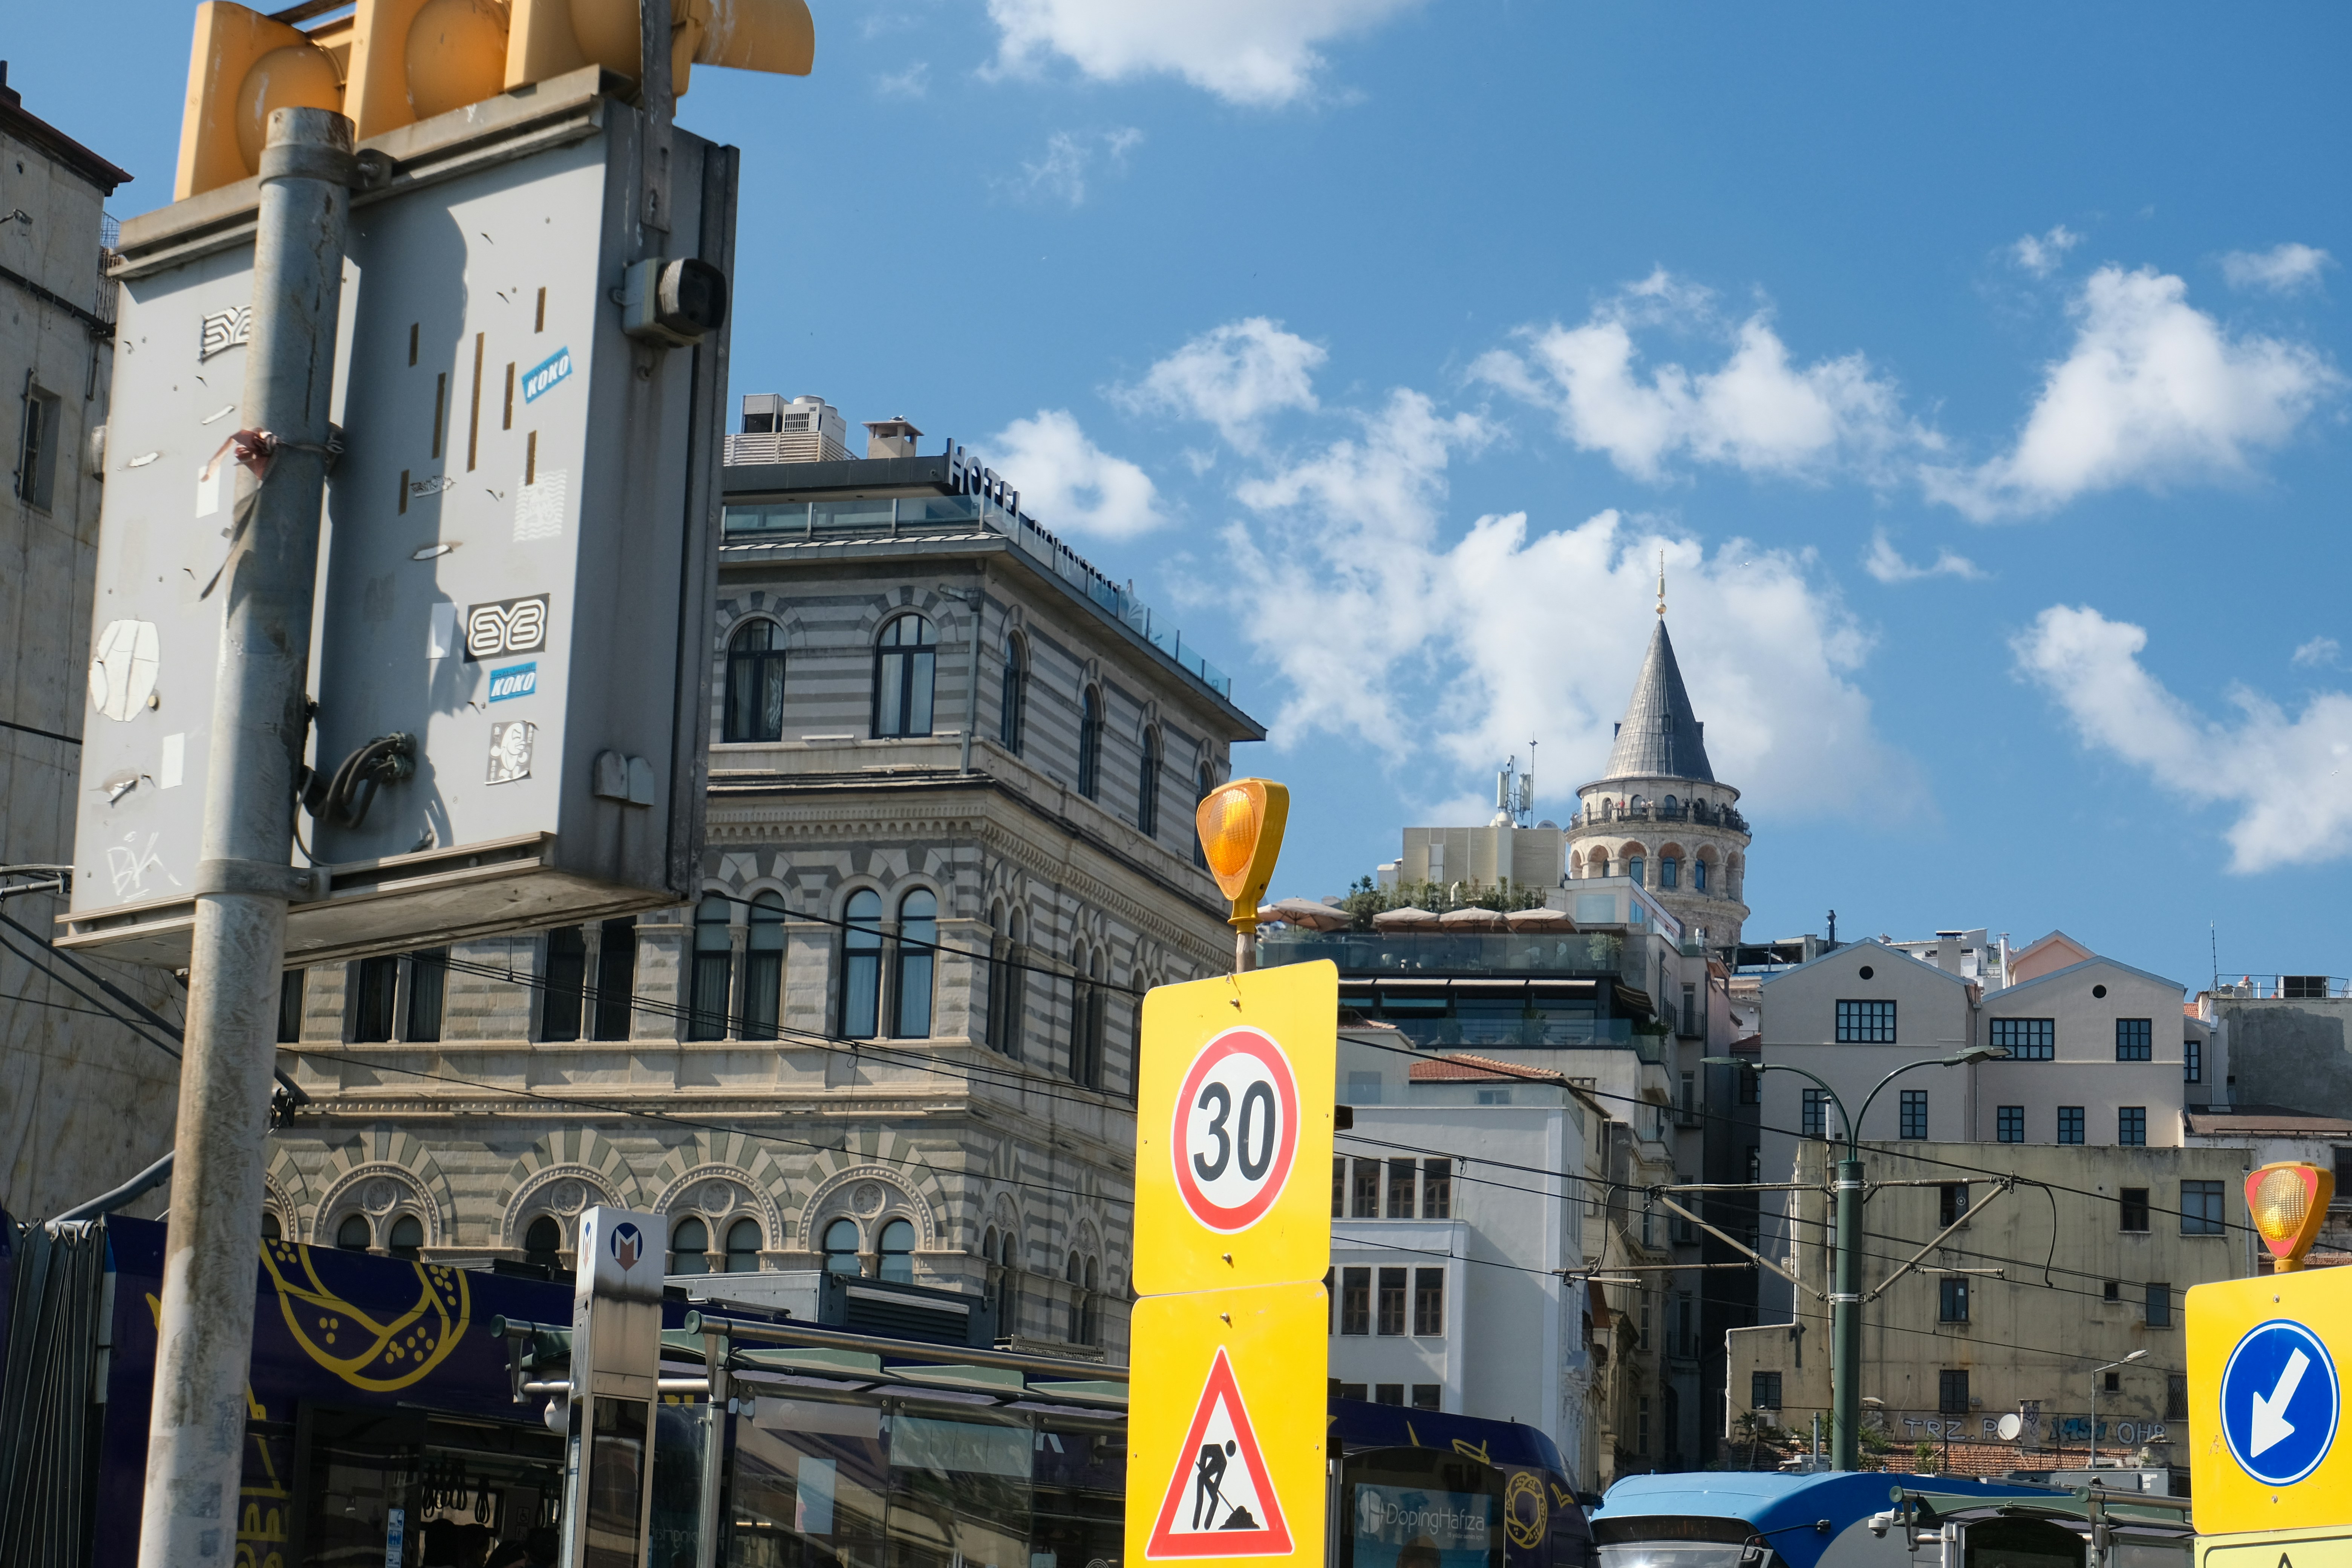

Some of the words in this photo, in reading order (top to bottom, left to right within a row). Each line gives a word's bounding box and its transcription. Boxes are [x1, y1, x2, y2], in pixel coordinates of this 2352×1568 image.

[527, 355, 568, 398] KOKO
[947, 438, 1020, 530] HOTEL
[491, 672, 535, 697] KOKO
[1193, 1080, 1276, 1182] 30
